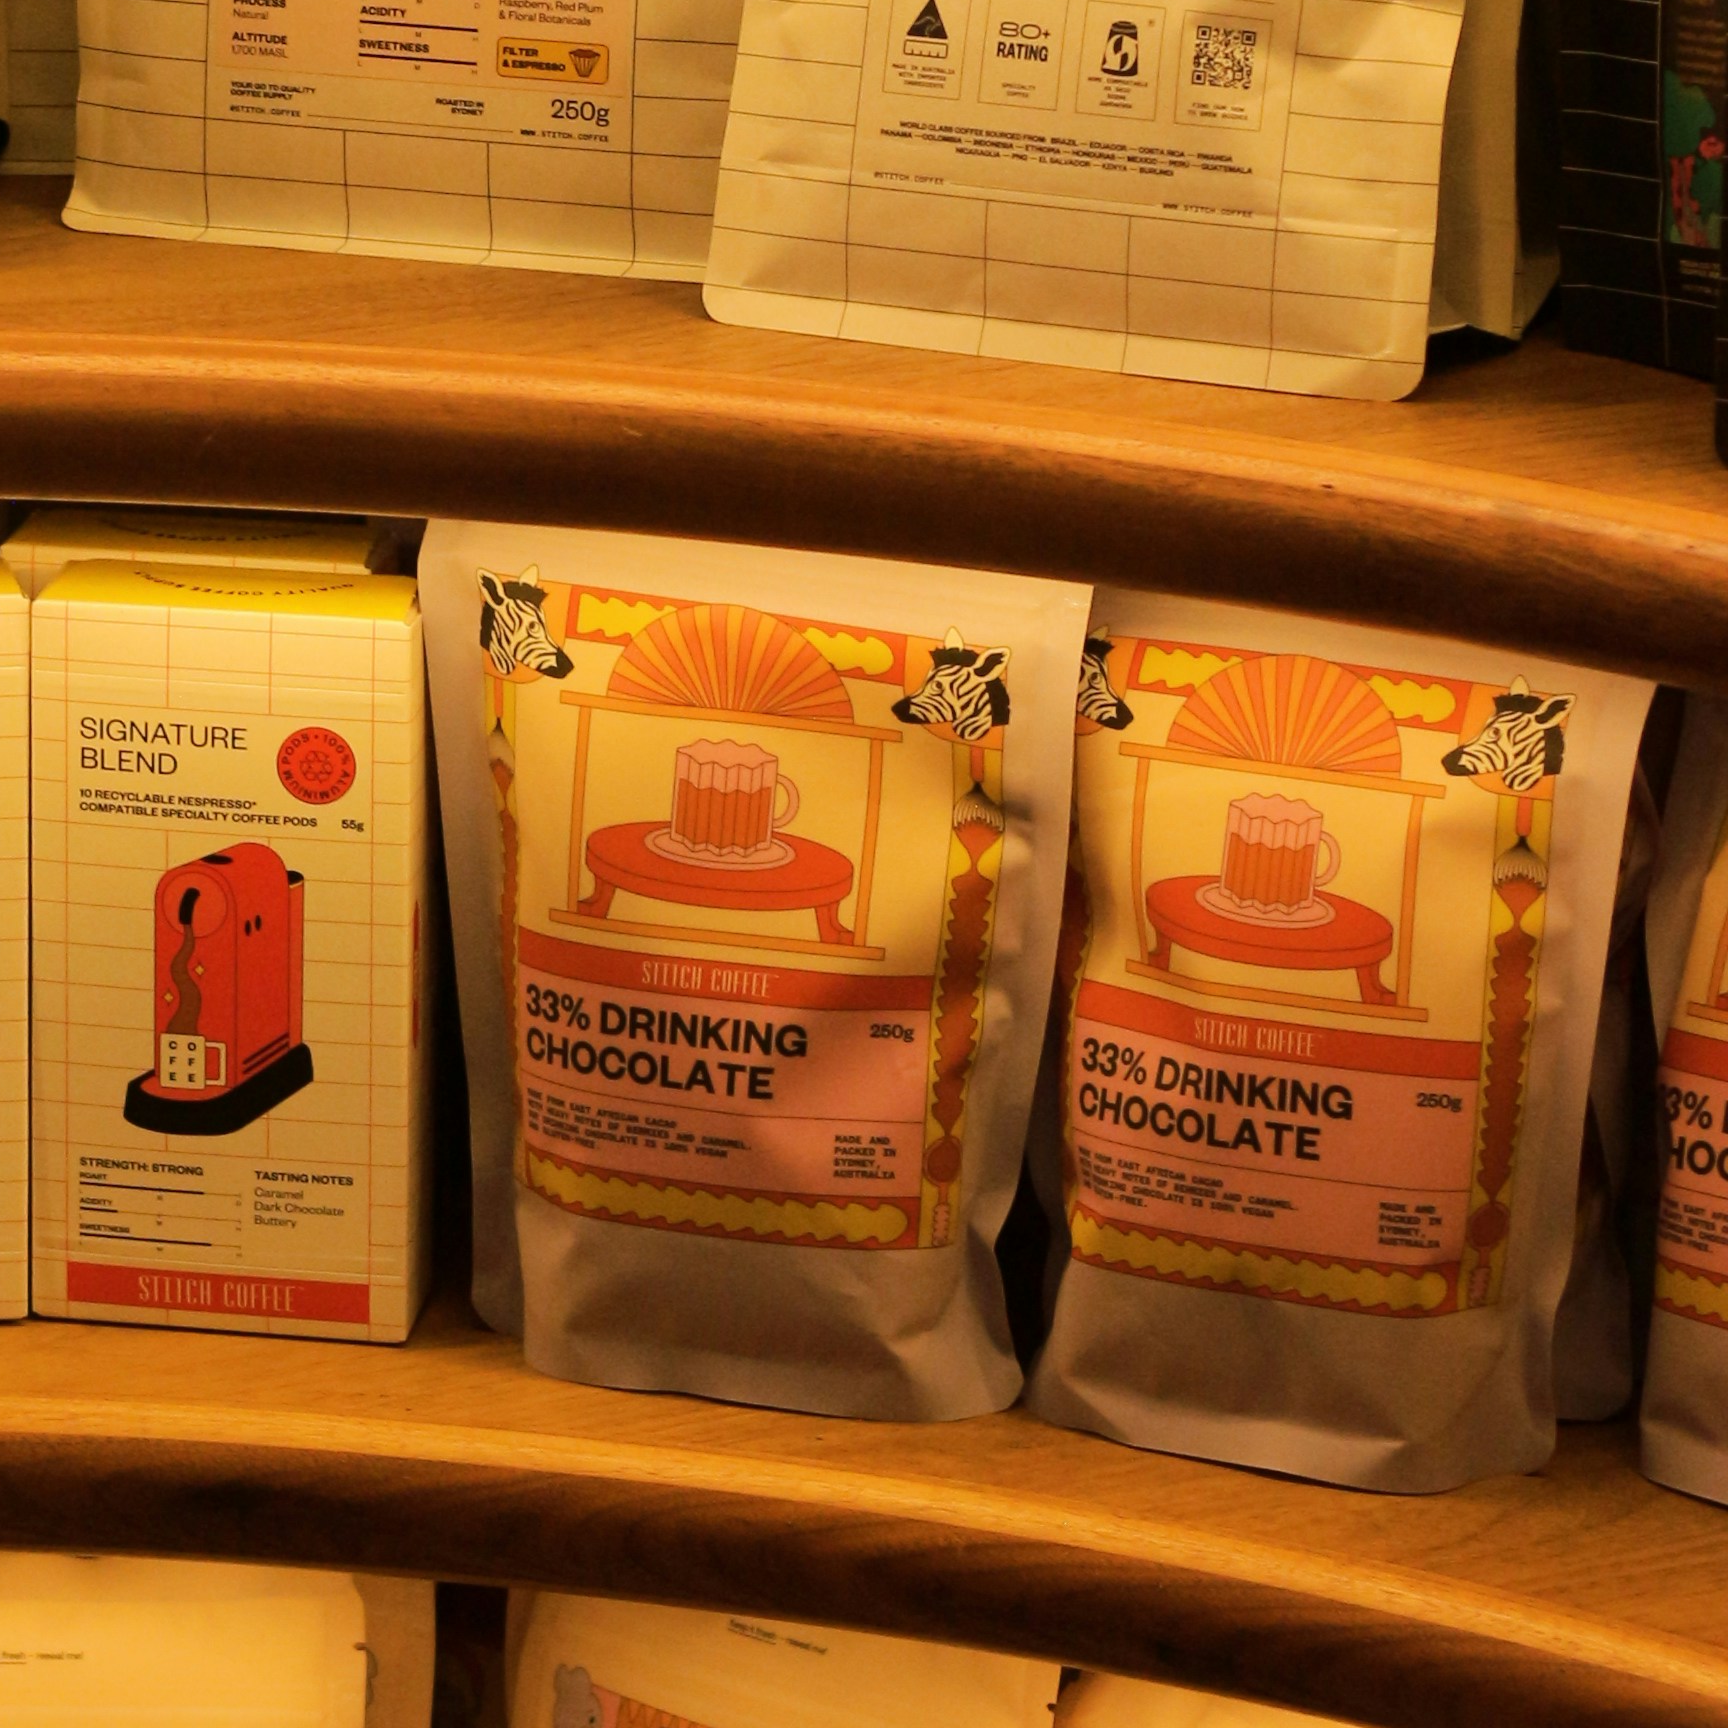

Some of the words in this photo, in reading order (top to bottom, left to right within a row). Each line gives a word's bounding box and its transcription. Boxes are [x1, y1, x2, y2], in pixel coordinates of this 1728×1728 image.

[360, 6, 406, 18] ACIDITY
[232, 32, 287, 44] ALTITUDE
[999, 22, 1051, 39] 80+
[359, 39, 429, 53] SWEETNESS
[503, 47, 539, 57] FILTER
[997, 43, 1048, 62] RATING
[551, 99, 609, 127] 250g
[80, 717, 247, 750] SIGNATURE
[80, 747, 178, 775] BLEND
[79, 789, 92, 799] 10
[95, 790, 175, 805] RECYCLABLE
[79, 802, 165, 818] COMPATIBLE
[161, 807, 228, 821] SPECIALTY
[232, 813, 281, 825] COFFEE
[283, 816, 318, 827] PODS
[341, 819, 364, 831] 55g
[641, 961, 702, 991] STITCH
[710, 968, 771, 998] COFFEE
[526, 983, 590, 1030] 33%
[600, 1002, 808, 1057] DRINKING
[870, 1023, 914, 1043] 250g
[526, 1027, 774, 1100] CHOCOLATE
[1081, 1038, 1147, 1086] 33%
[1155, 1056, 1354, 1120] DRINKING
[1416, 1092, 1462, 1113] 250g
[1079, 1082, 1320, 1161] CHOCOLATE
[834, 1134, 863, 1145] MADE
[869, 1136, 890, 1146] AND
[834, 1146, 875, 1157] PACKED
[883, 1147, 897, 1158] IN
[80, 1157, 149, 1171] STRENGTH:
[152, 1162, 204, 1176] STRONG
[832, 1169, 896, 1180] AUSTRALIA
[254, 1171, 308, 1183] TASTING
[312, 1174, 353, 1186] NOTES
[254, 1187, 303, 1200] Caramel
[254, 1201, 281, 1213] Dark
[284, 1203, 344, 1217] Chocolate
[254, 1215, 296, 1229] Buttery
[138, 1275, 211, 1306] STITCH
[224, 1281, 296, 1312] COFFEE
